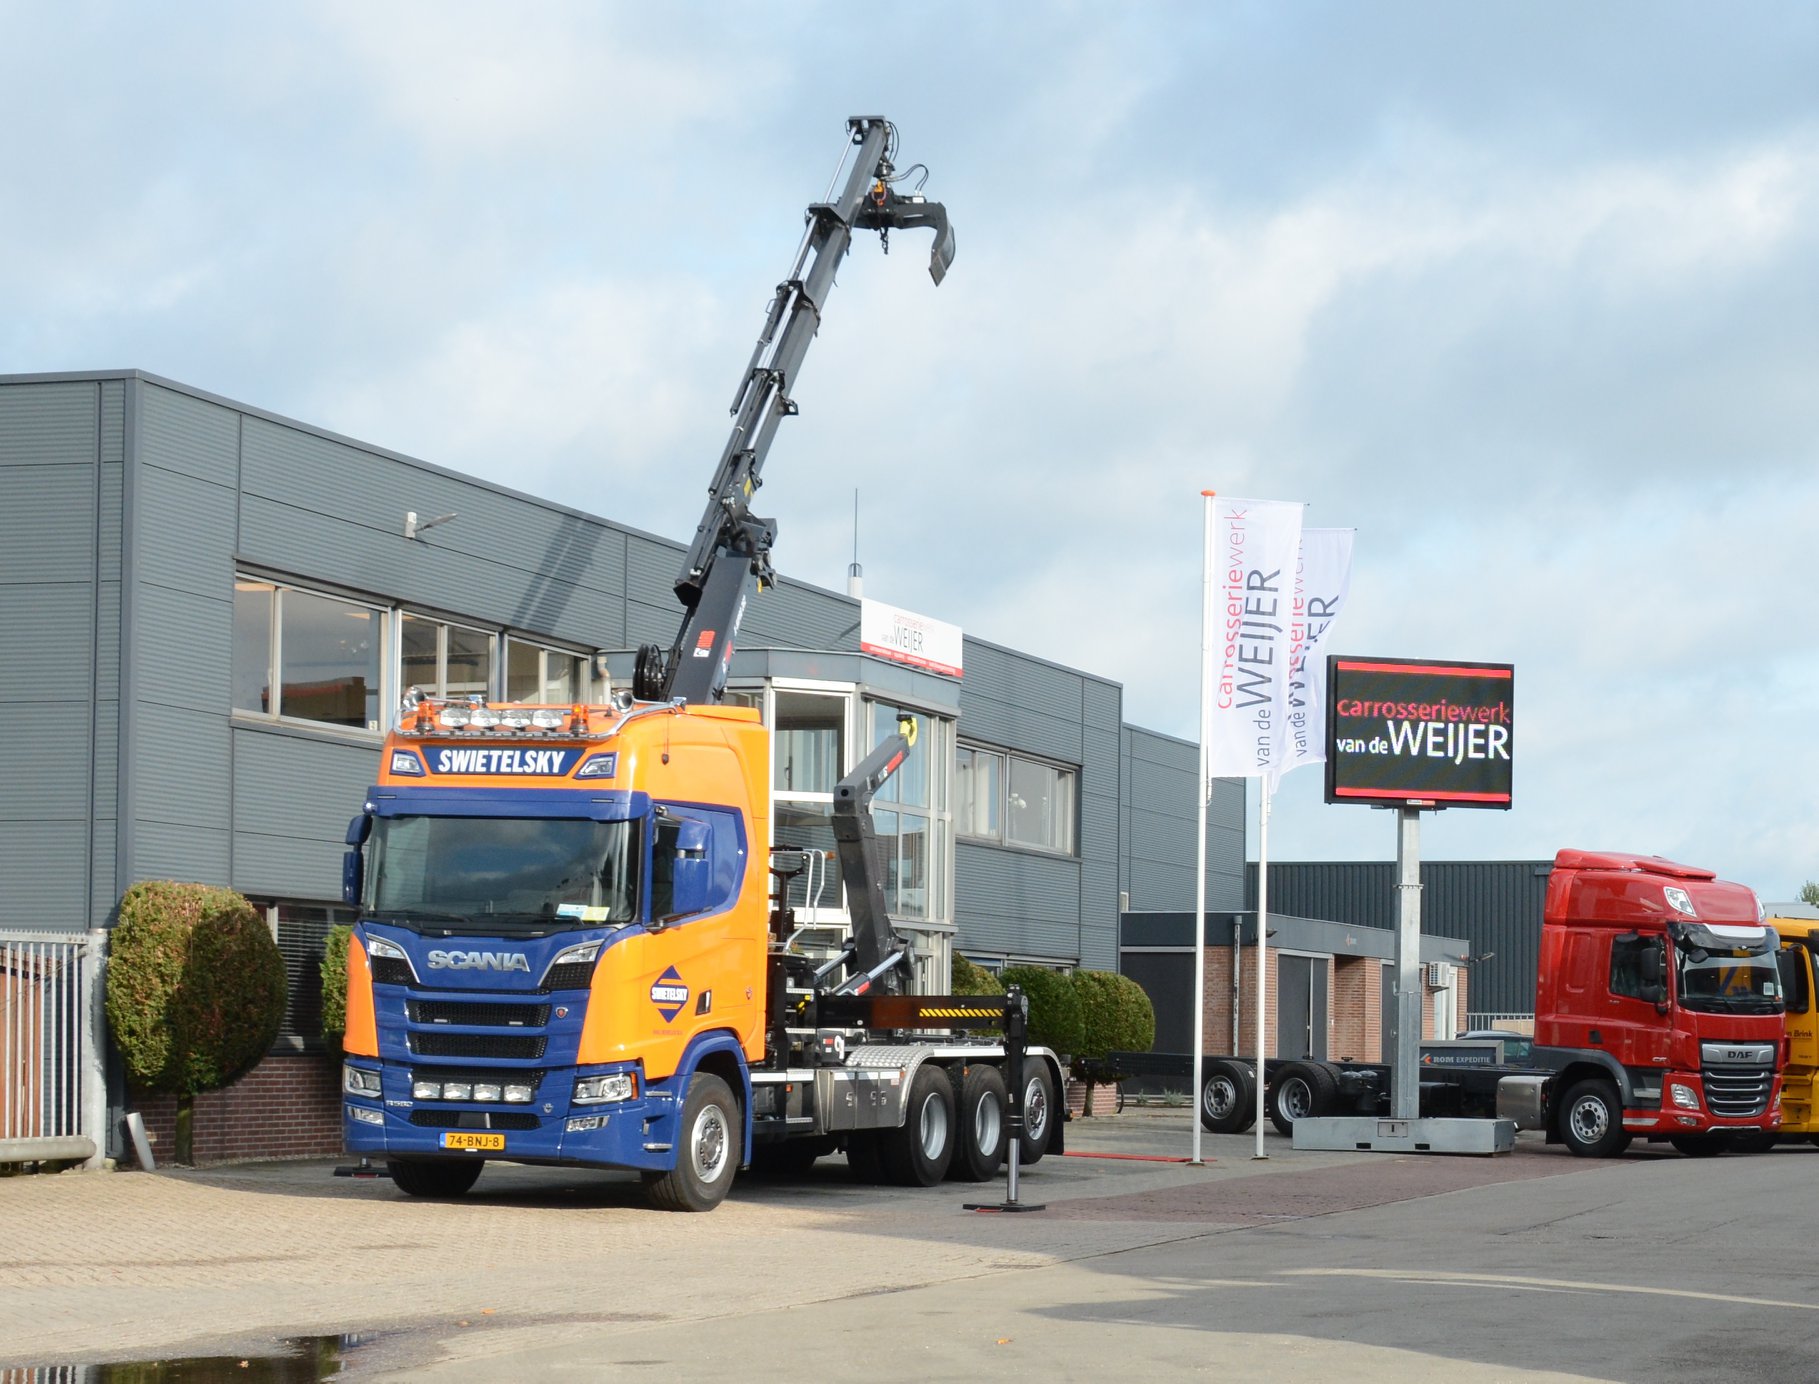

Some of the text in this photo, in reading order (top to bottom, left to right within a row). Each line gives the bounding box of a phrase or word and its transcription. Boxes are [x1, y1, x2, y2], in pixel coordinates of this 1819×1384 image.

[1218, 509, 1247, 709] carrosseriewerk
[894, 624, 924, 653] WEIJER
[1236, 569, 1283, 767] van de WEIJER
[1336, 699, 1511, 723] carrosseriewerk
[1294, 730, 1308, 757] van
[1336, 720, 1510, 765] van de WEIJER
[438, 750, 565, 773] SWIETELSKY
[427, 950, 530, 972] SCANIA
[1794, 1029, 1813, 1037] Brink
[449, 1135, 499, 1147] 74-BNJ-8
